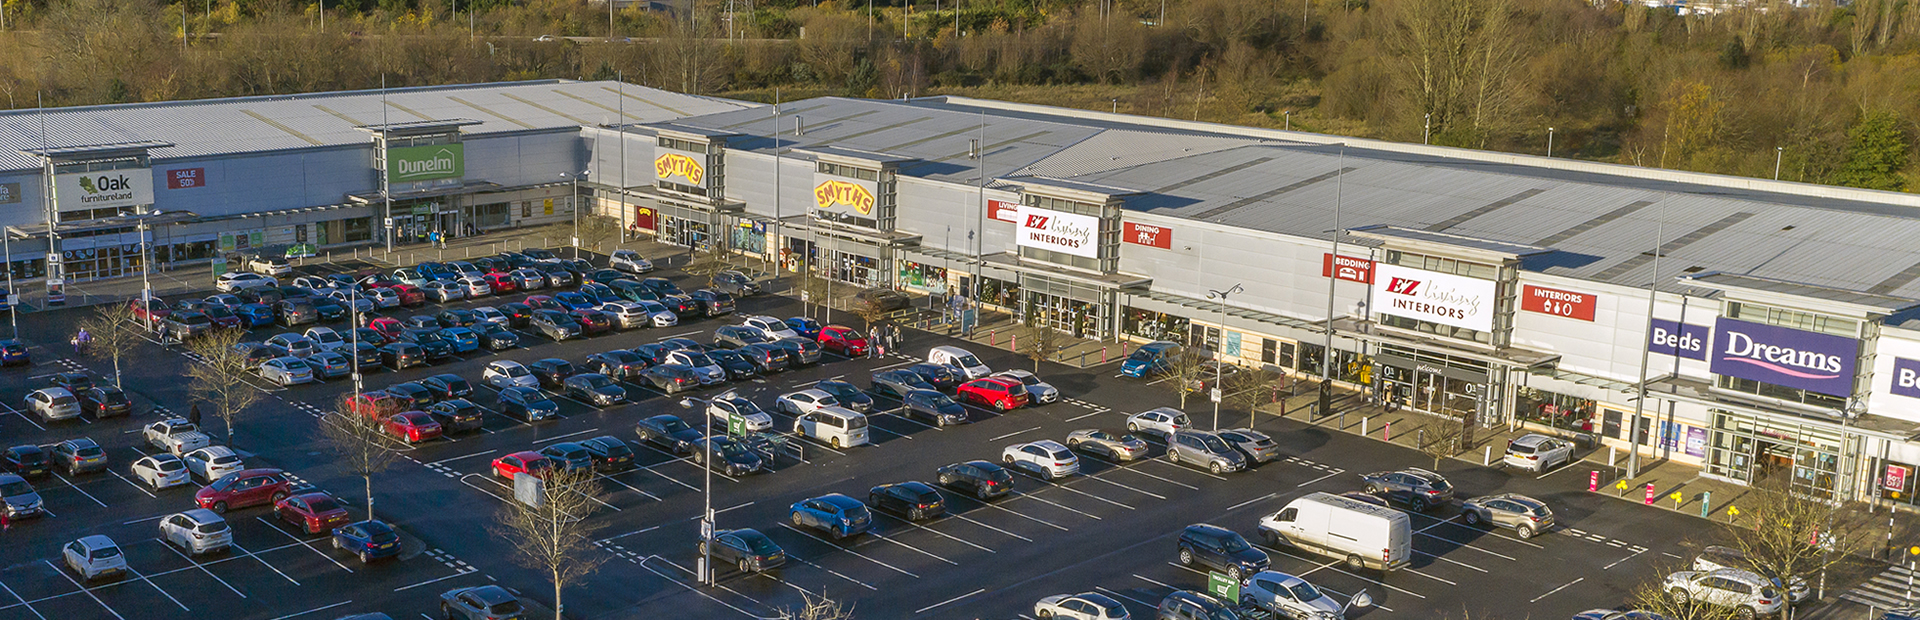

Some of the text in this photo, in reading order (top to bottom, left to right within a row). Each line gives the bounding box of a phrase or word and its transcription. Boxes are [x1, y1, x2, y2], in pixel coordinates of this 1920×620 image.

[398, 156, 452, 174] Dunelm
[656, 157, 701, 182] SMYTHS
[97, 174, 131, 191] Oak
[176, 170, 196, 179] SALE
[80, 192, 132, 203] furnitureland
[816, 184, 871, 212] SMYTHS
[1025, 214, 1091, 245] EZ living
[1135, 224, 1160, 235] DINING
[1030, 232, 1080, 248] INTERIORS
[1335, 257, 1370, 270] BEDDING
[1385, 276, 1481, 316] EZ living
[1534, 288, 1583, 304] INTERIORS
[1393, 298, 1464, 320] INTERIORS
[1653, 327, 1701, 352] Beds
[1724, 331, 1841, 373] Dreams
